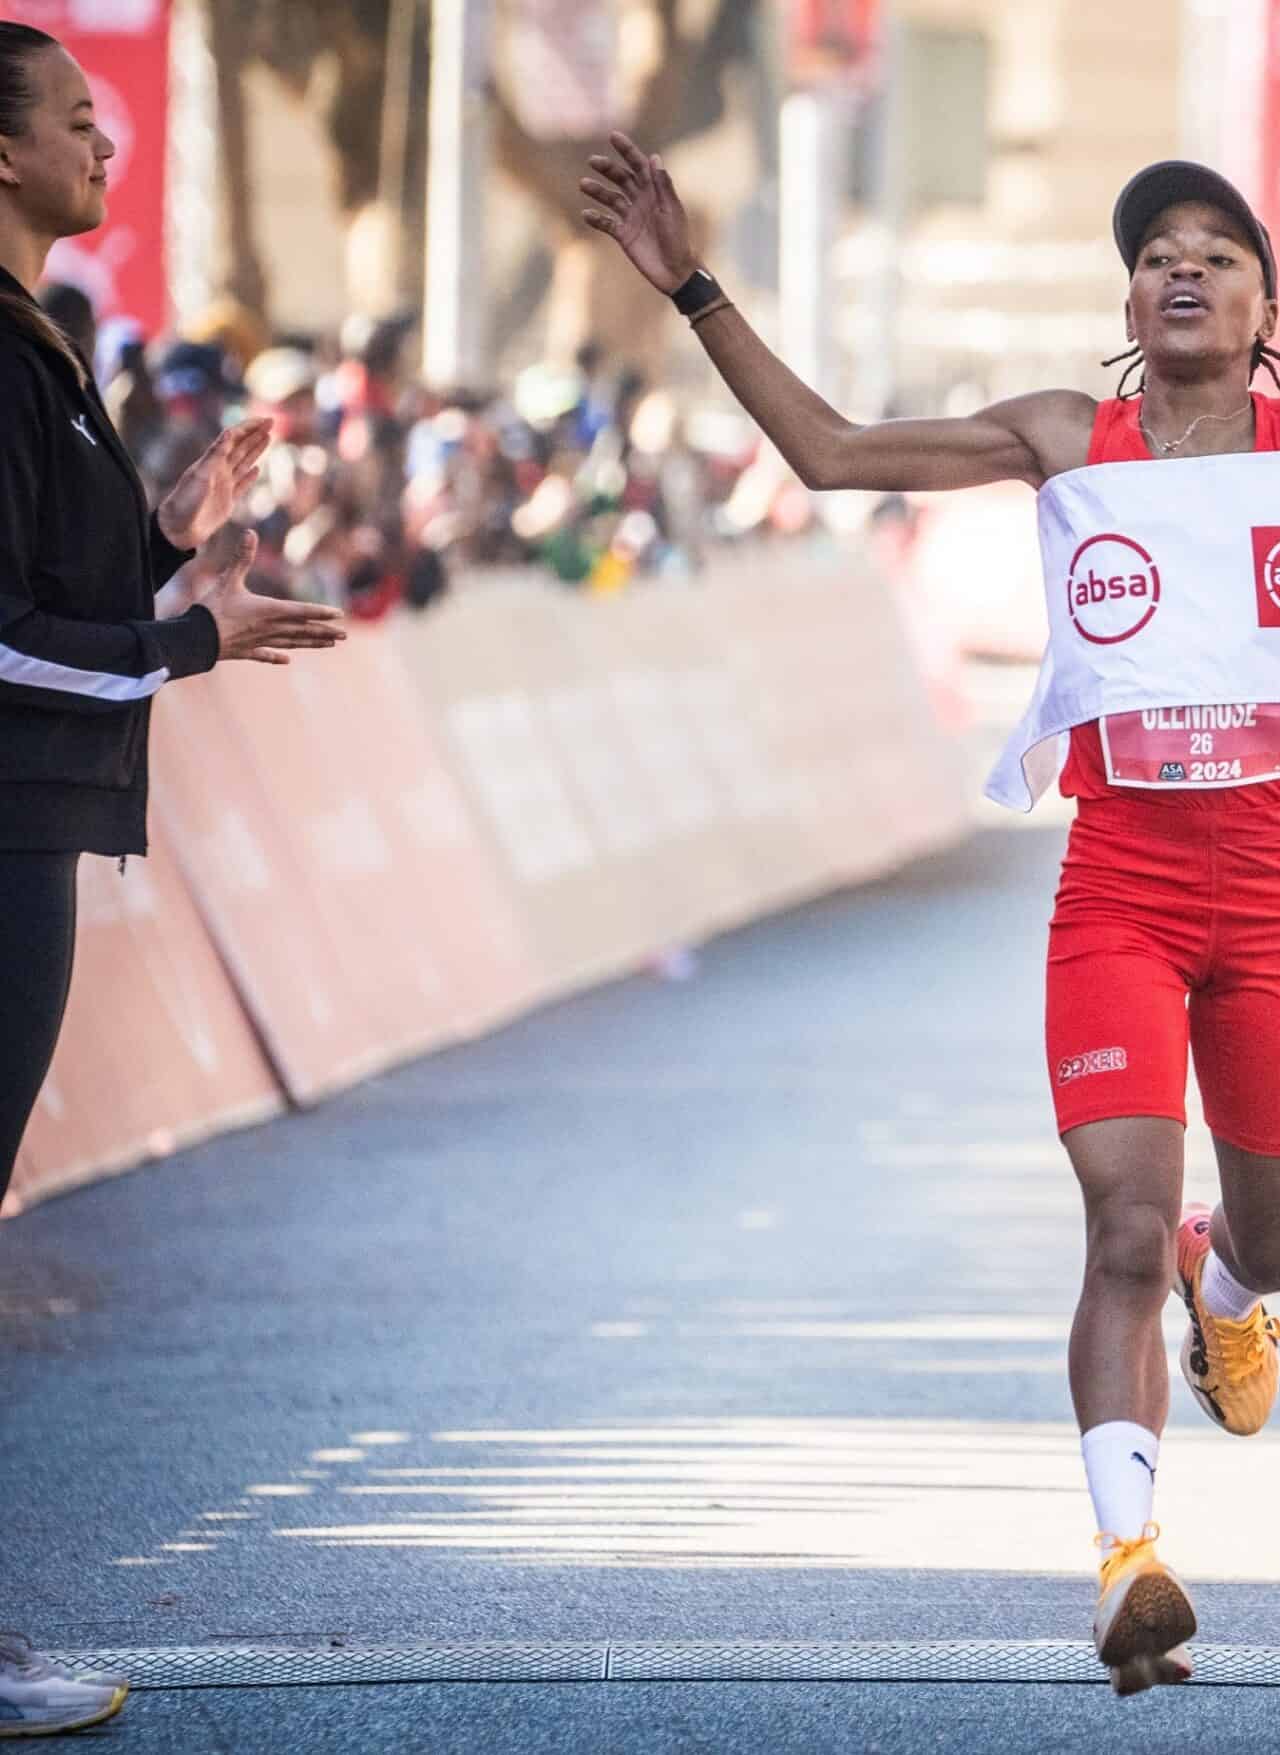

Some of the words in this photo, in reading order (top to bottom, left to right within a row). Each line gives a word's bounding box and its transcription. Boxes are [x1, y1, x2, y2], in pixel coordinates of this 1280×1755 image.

[1075, 569, 1148, 607] absa
[1189, 732, 1214, 755] 26
[1161, 764, 1184, 774] ASA
[1189, 759, 1242, 781] 2024
